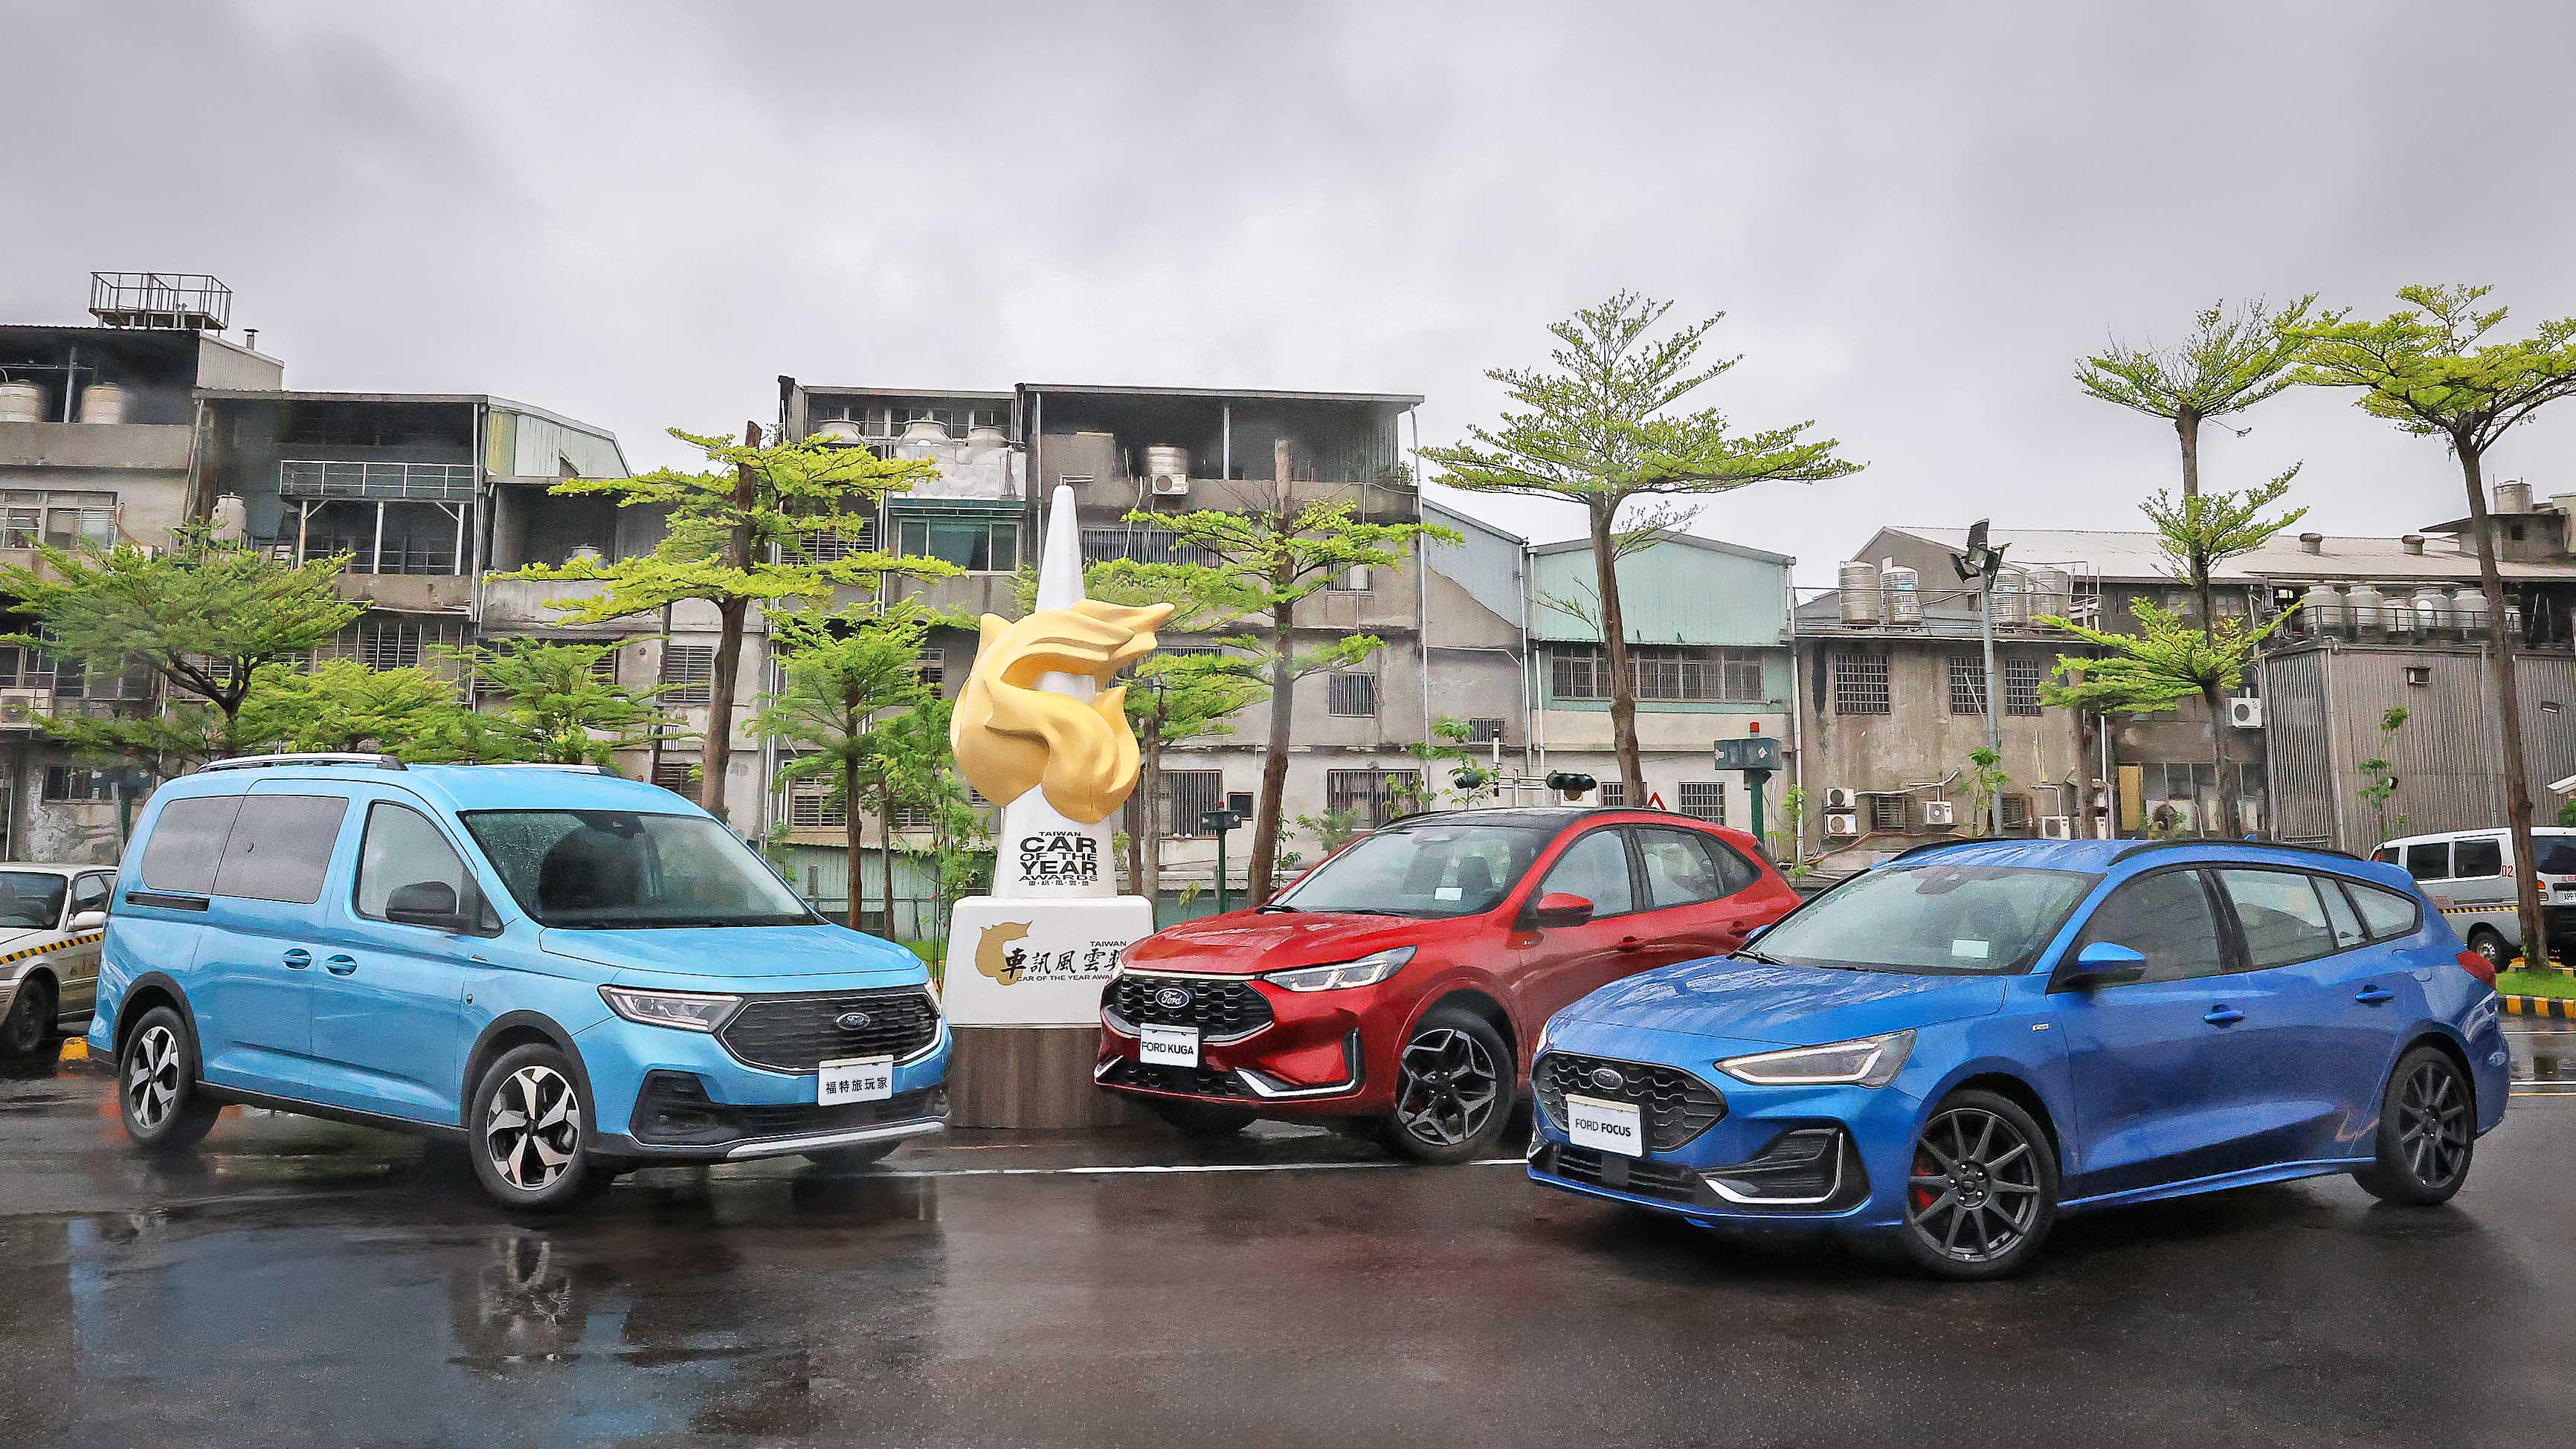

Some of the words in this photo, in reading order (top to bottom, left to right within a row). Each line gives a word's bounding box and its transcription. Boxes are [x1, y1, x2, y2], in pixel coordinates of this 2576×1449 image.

[1020, 836, 1097, 853] CAR
[1020, 853, 1048, 861] OF
[1057, 852, 1097, 862] THE
[1020, 861, 1097, 876] YEAR
[2502, 865, 2514, 877] 02
[1161, 990, 1183, 1005] Ford
[1142, 1042, 1166, 1053] FORD
[1168, 1044, 1194, 1055] KUGA
[825, 1077, 887, 1094] 福特旅玩家
[1575, 1118, 1599, 1132] FORD
[1601, 1123, 1631, 1137] FOCUS
